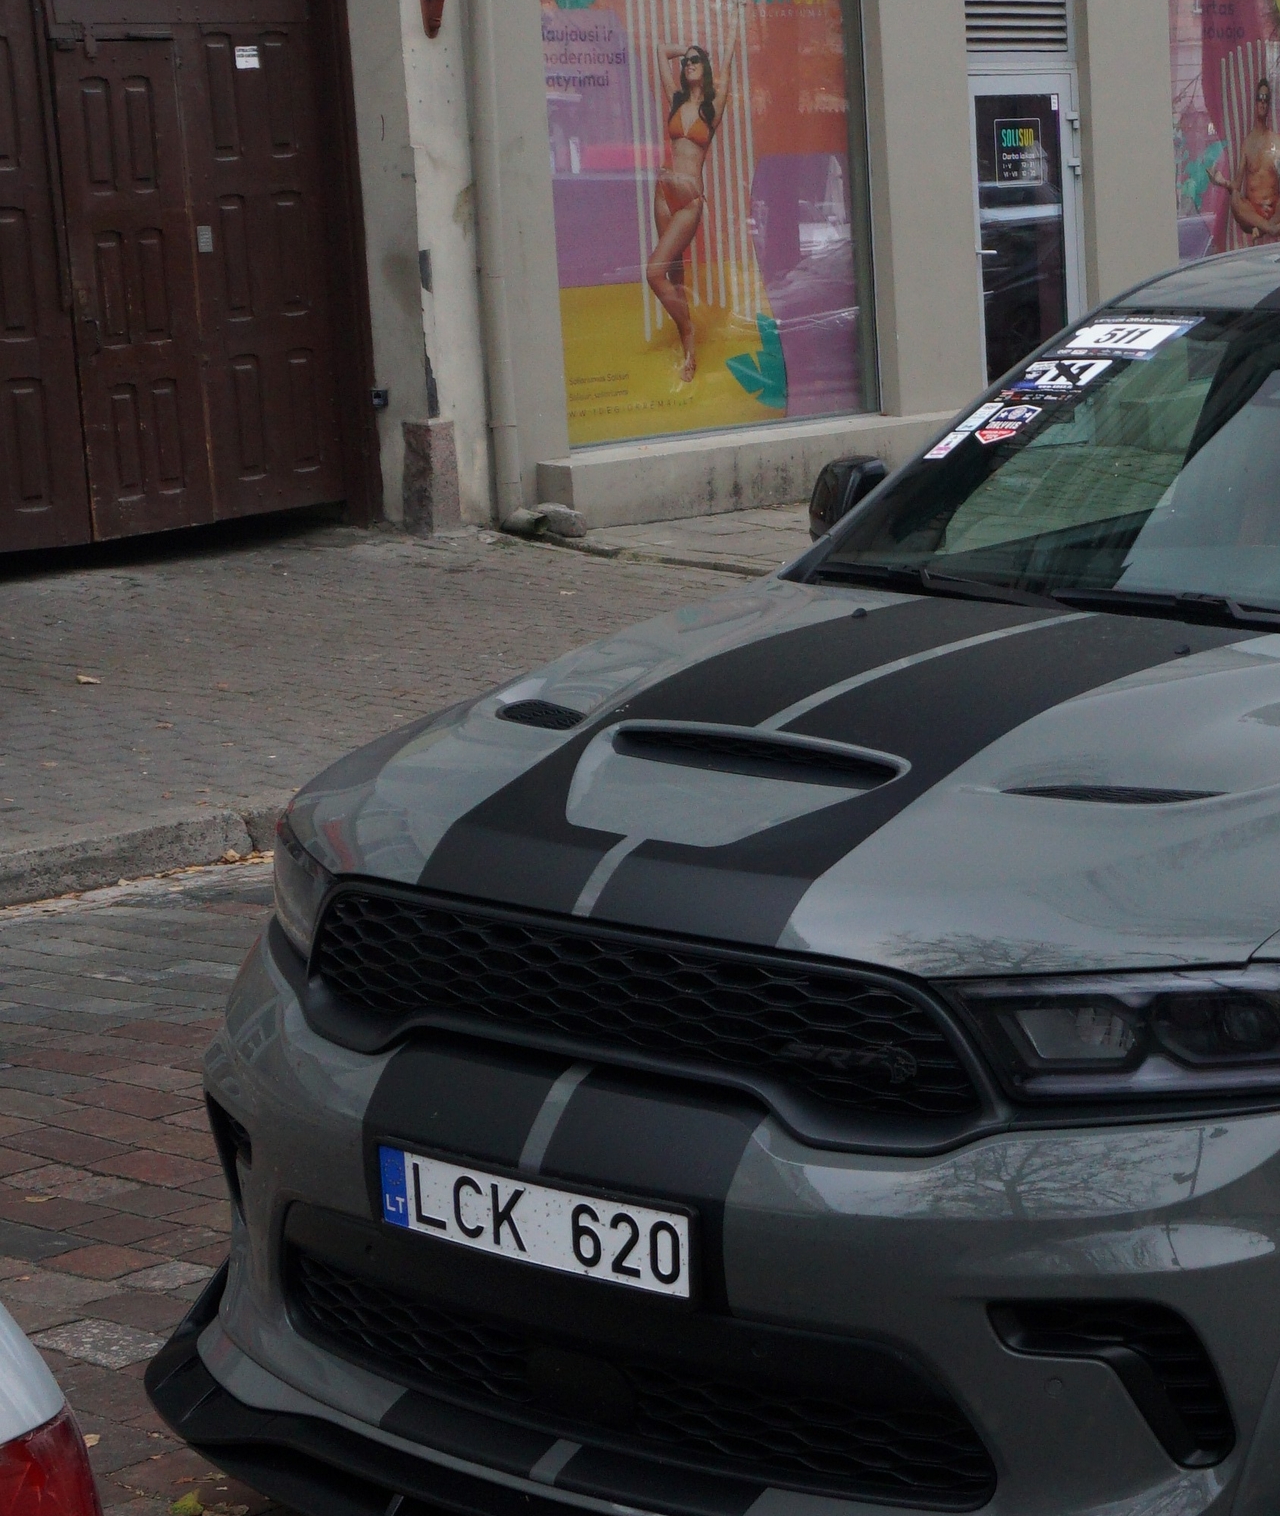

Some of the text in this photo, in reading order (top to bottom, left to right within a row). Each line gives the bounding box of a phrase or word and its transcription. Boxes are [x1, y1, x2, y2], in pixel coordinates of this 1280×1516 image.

[602, 25, 613, 42] ir
[1001, 128, 1034, 147] SOLISUN
[1093, 327, 1153, 344] 511
[385, 1192, 405, 1215] LT
[412, 1162, 681, 1285] LCK 620
